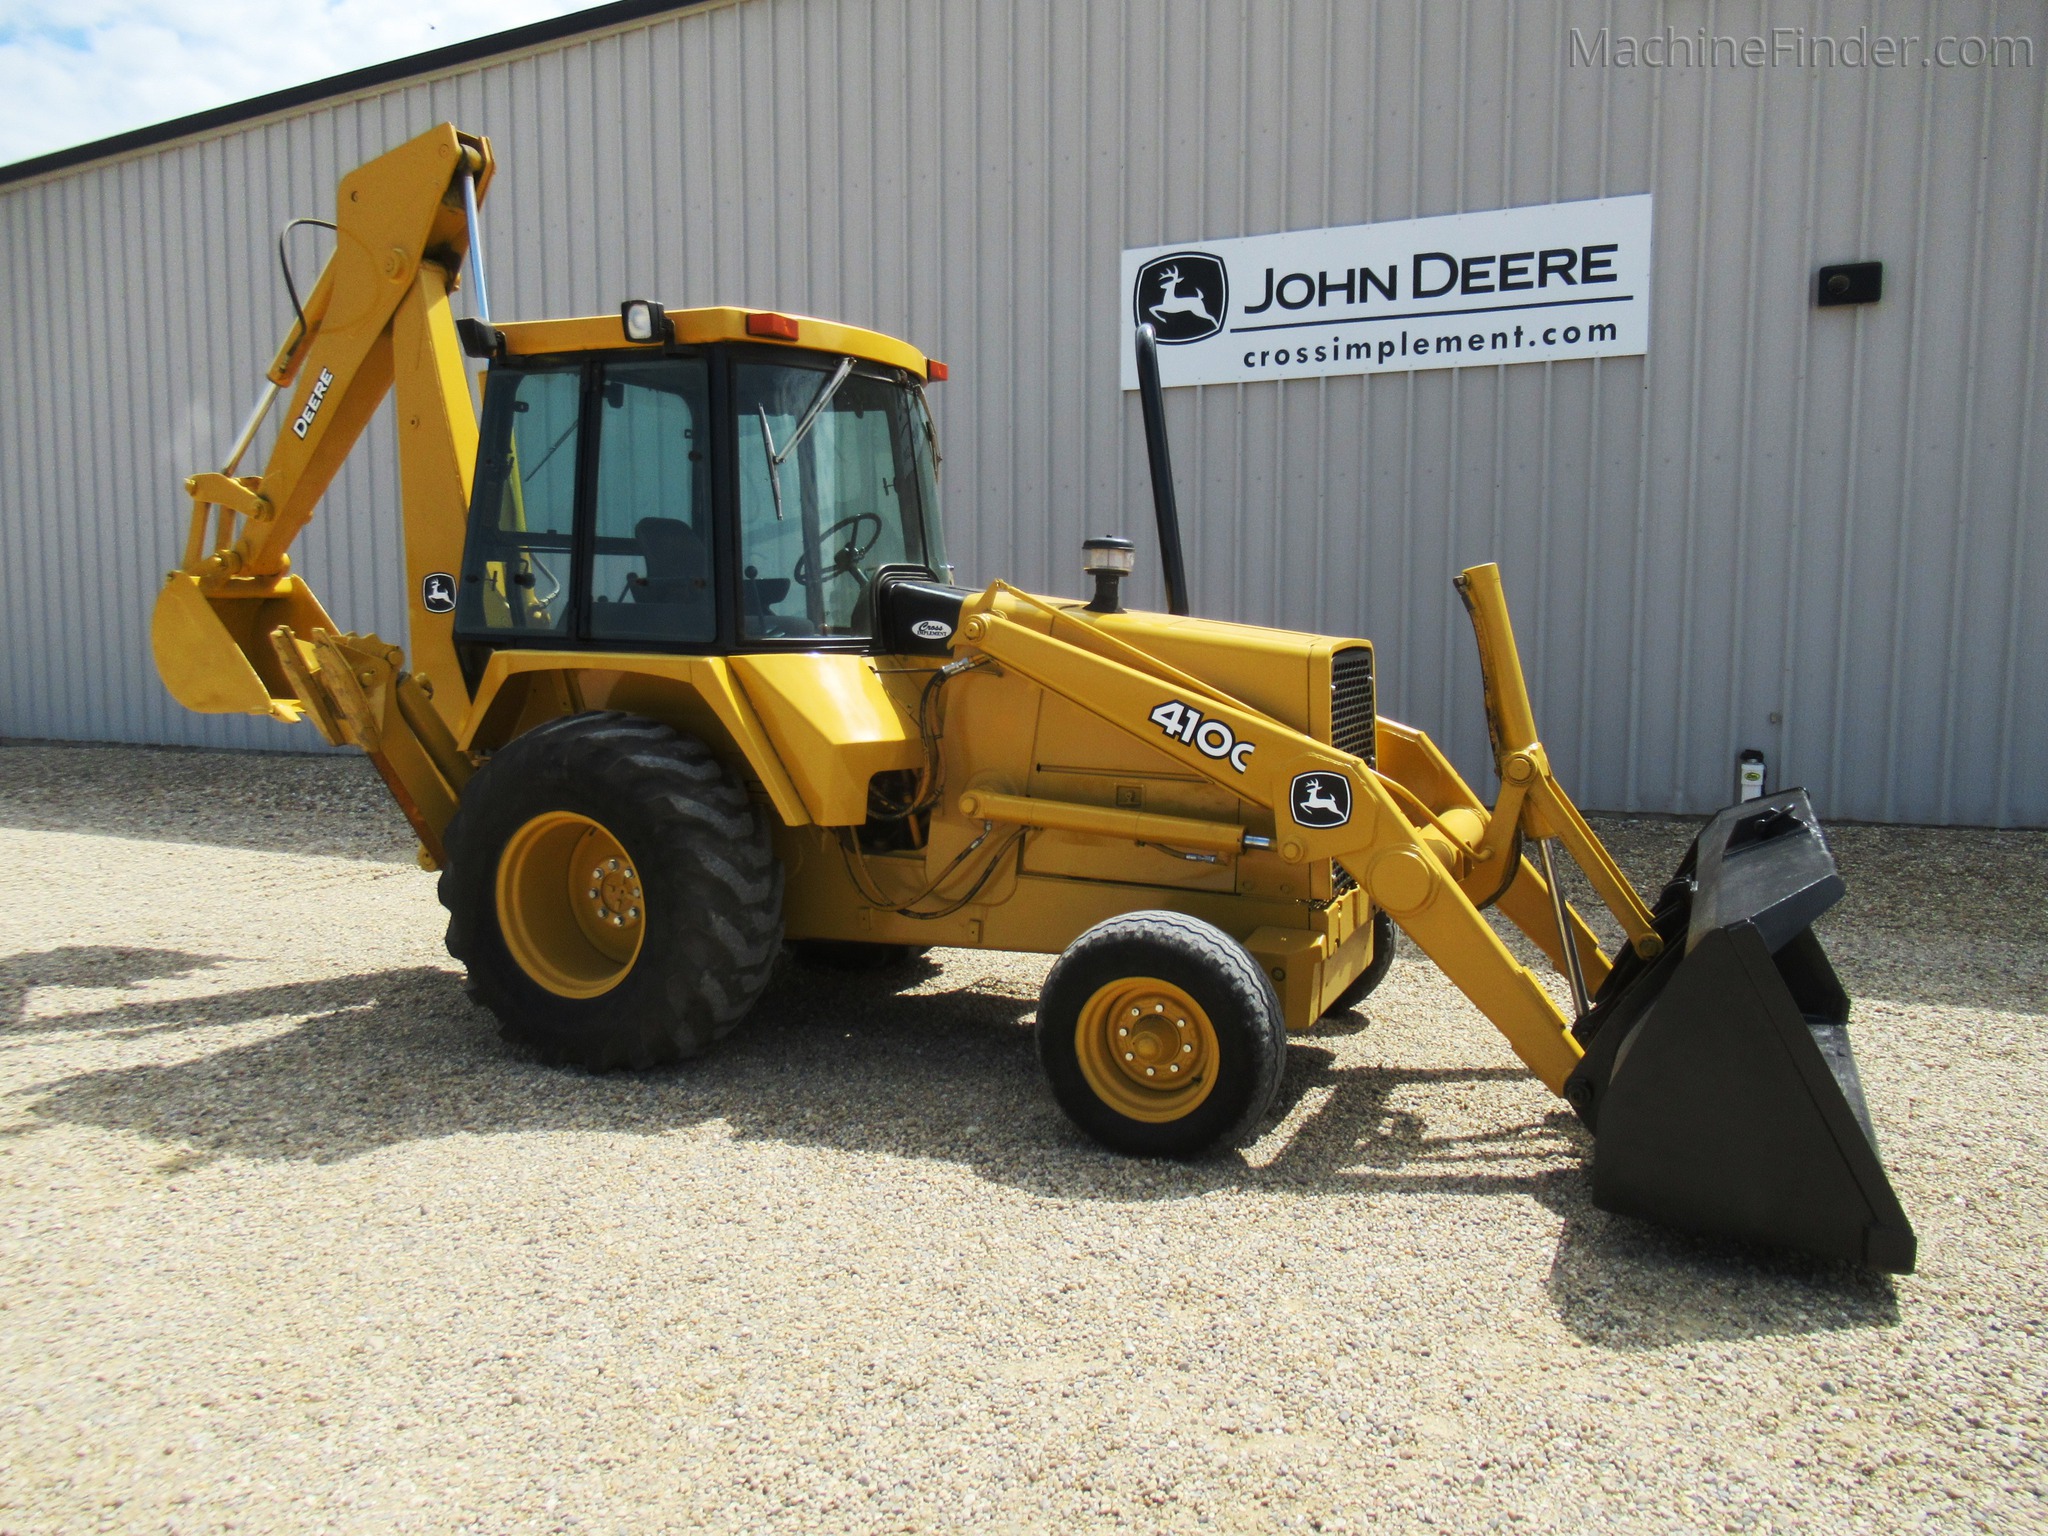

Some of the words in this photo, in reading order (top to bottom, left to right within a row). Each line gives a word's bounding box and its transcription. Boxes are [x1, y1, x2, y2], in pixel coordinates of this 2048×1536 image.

[1244, 264, 1398, 315] JOHN
[1412, 243, 1618, 300] DEERE
[1243, 322, 1617, 367] crossimplement.com
[292, 367, 334, 440] DEERE
[918, 621, 943, 632] Cross
